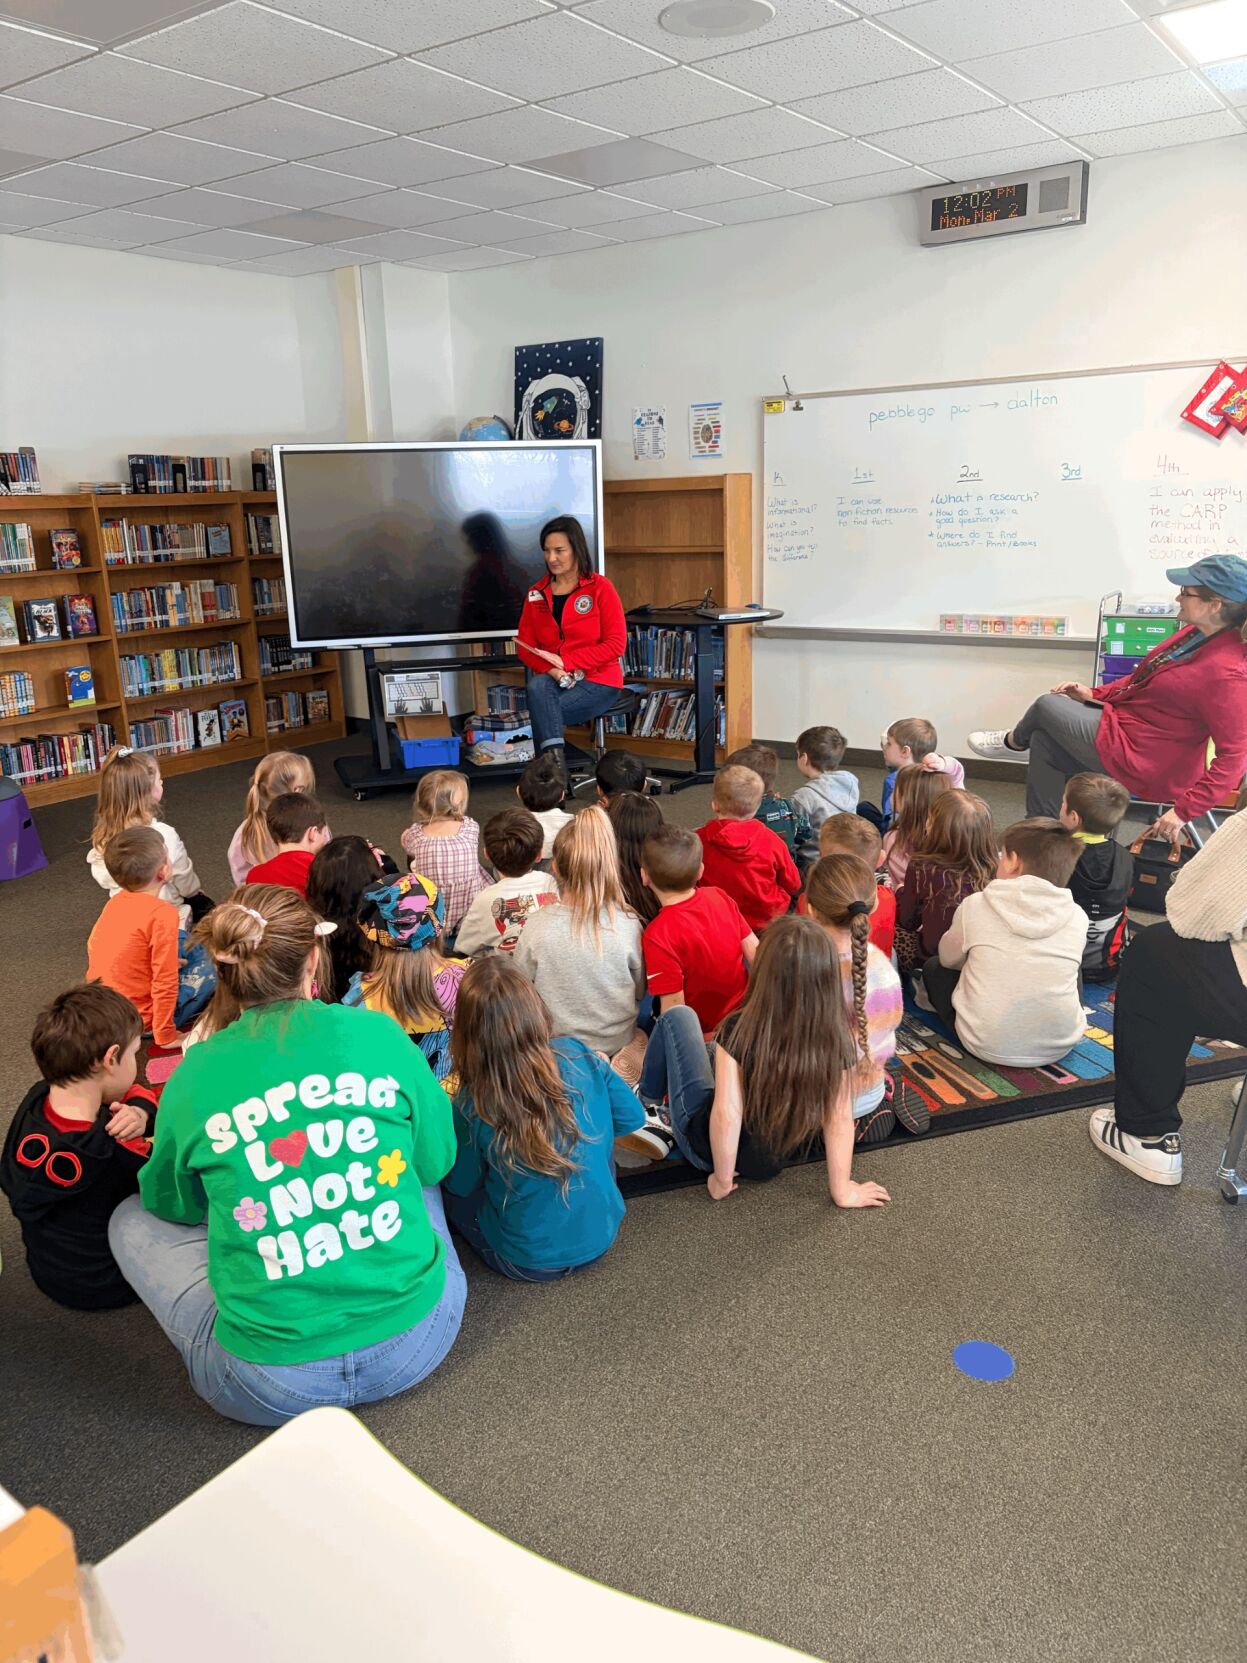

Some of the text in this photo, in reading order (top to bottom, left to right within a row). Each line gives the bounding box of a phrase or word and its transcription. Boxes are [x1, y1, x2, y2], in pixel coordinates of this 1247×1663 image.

[943, 185, 1016, 213] 12:02 PM
[974, 207, 1001, 224] Mar
[1008, 202, 1019, 218] 2
[1007, 388, 1058, 410] dalton
[960, 465, 980, 478] 2nd
[1061, 463, 1081, 478] 3rd
[1157, 455, 1180, 474] 4th
[853, 467, 873, 479] 1st
[836, 496, 845, 505] I
[850, 498, 864, 506] can
[935, 492, 972, 504] What
[989, 491, 1040, 502] research?
[1150, 486, 1162, 497] I
[1203, 486, 1242, 503] apply
[935, 508, 954, 517] How
[957, 508, 969, 516] do
[1180, 503, 1228, 519] CARP
[935, 517, 954, 529] good
[1209, 519, 1221, 531] in
[269, 1161, 376, 1226] Not
[257, 1200, 402, 1280] Hate
